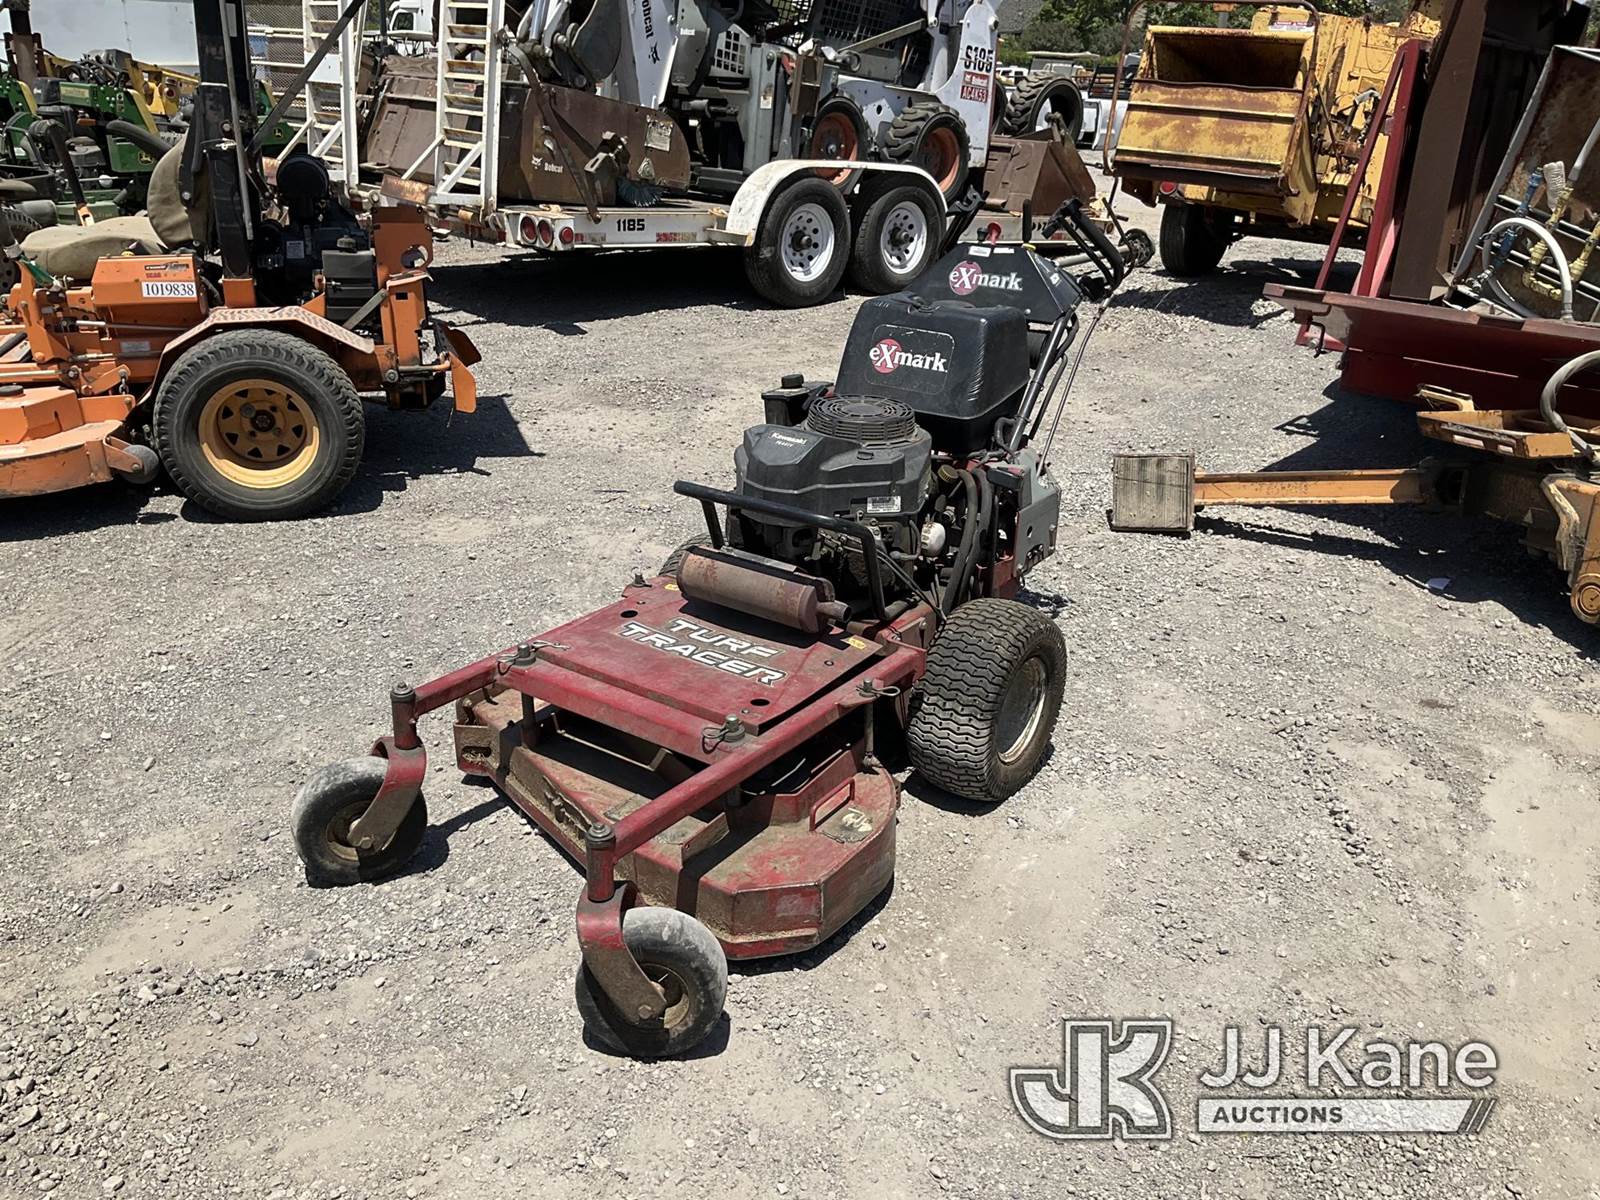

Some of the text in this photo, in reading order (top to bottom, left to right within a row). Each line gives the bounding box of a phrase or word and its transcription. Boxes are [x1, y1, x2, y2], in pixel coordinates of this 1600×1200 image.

[641, 0, 654, 39] obcat
[616, 218, 646, 232] 1185
[145, 283, 195, 296] 1019838
[621, 622, 786, 685] TRACER
[669, 619, 780, 657] TURF
